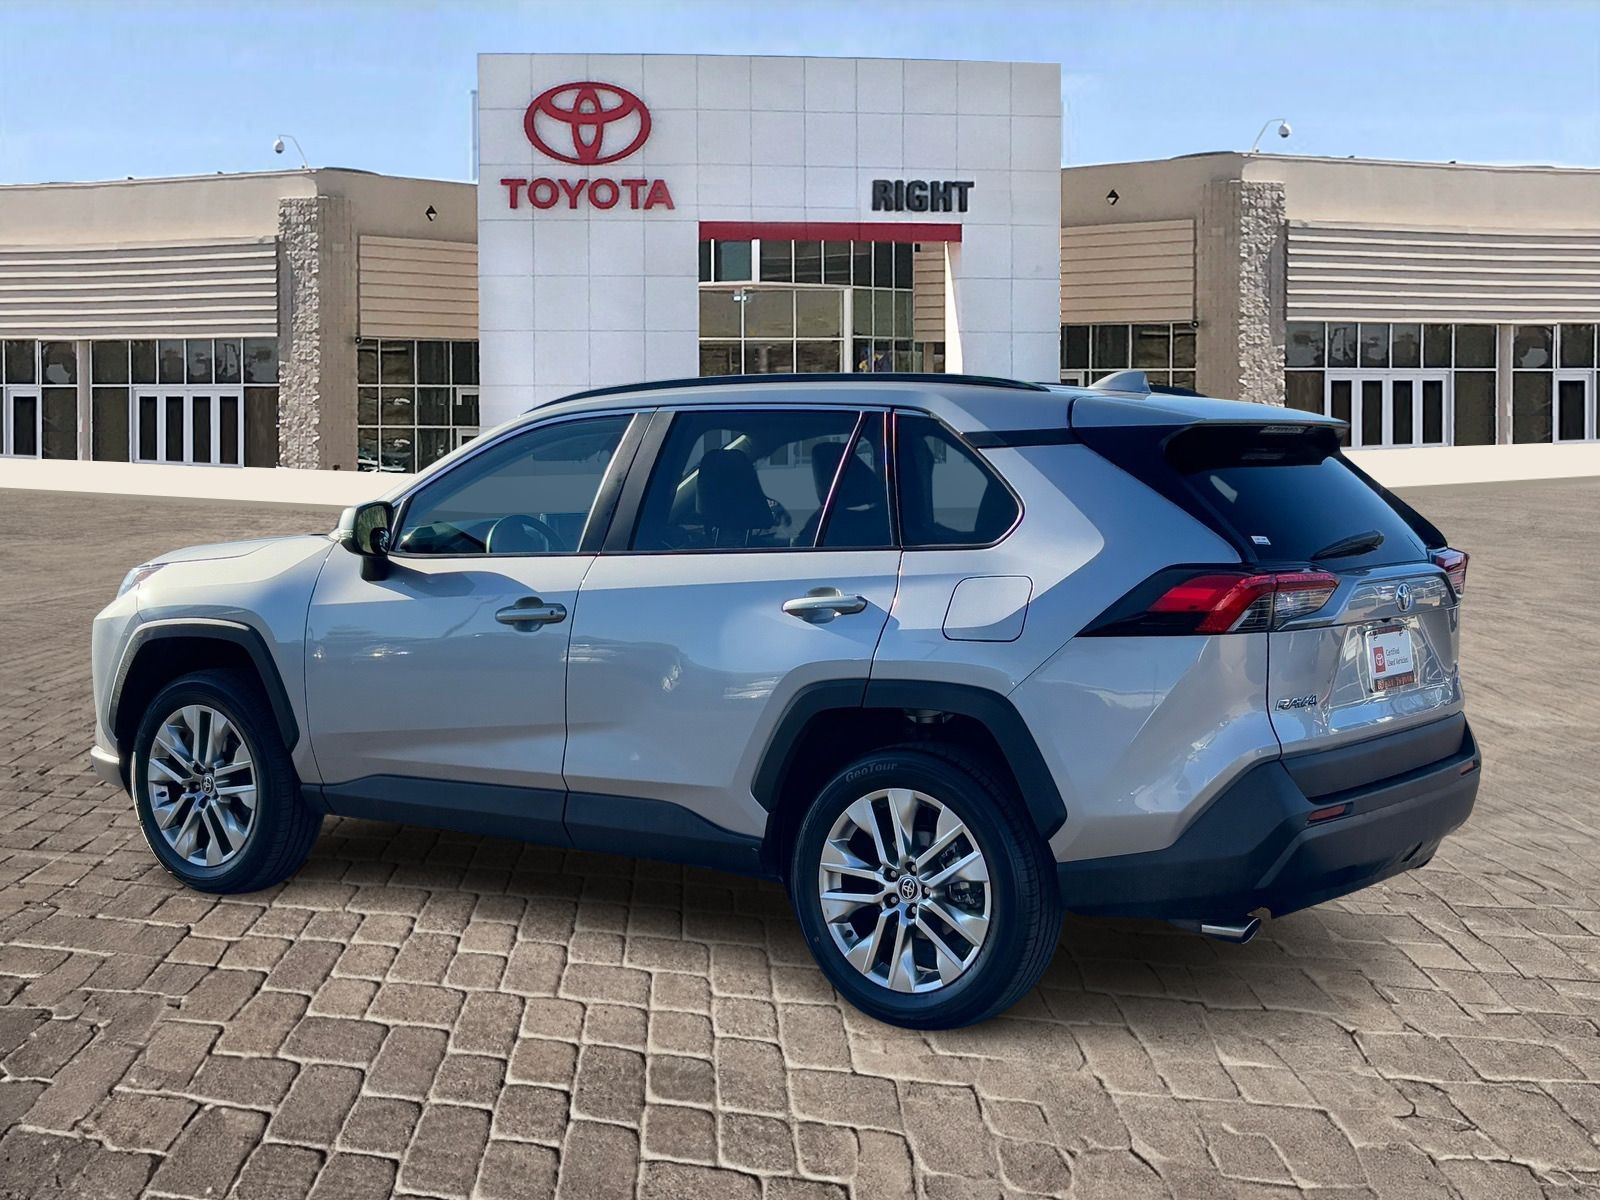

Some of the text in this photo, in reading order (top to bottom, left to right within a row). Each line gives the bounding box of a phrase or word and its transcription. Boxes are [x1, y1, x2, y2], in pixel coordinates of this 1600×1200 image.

[500, 177, 675, 209] TOYOTA
[872, 179, 975, 212] RIGHT
[845, 762, 898, 783] GeoTour
